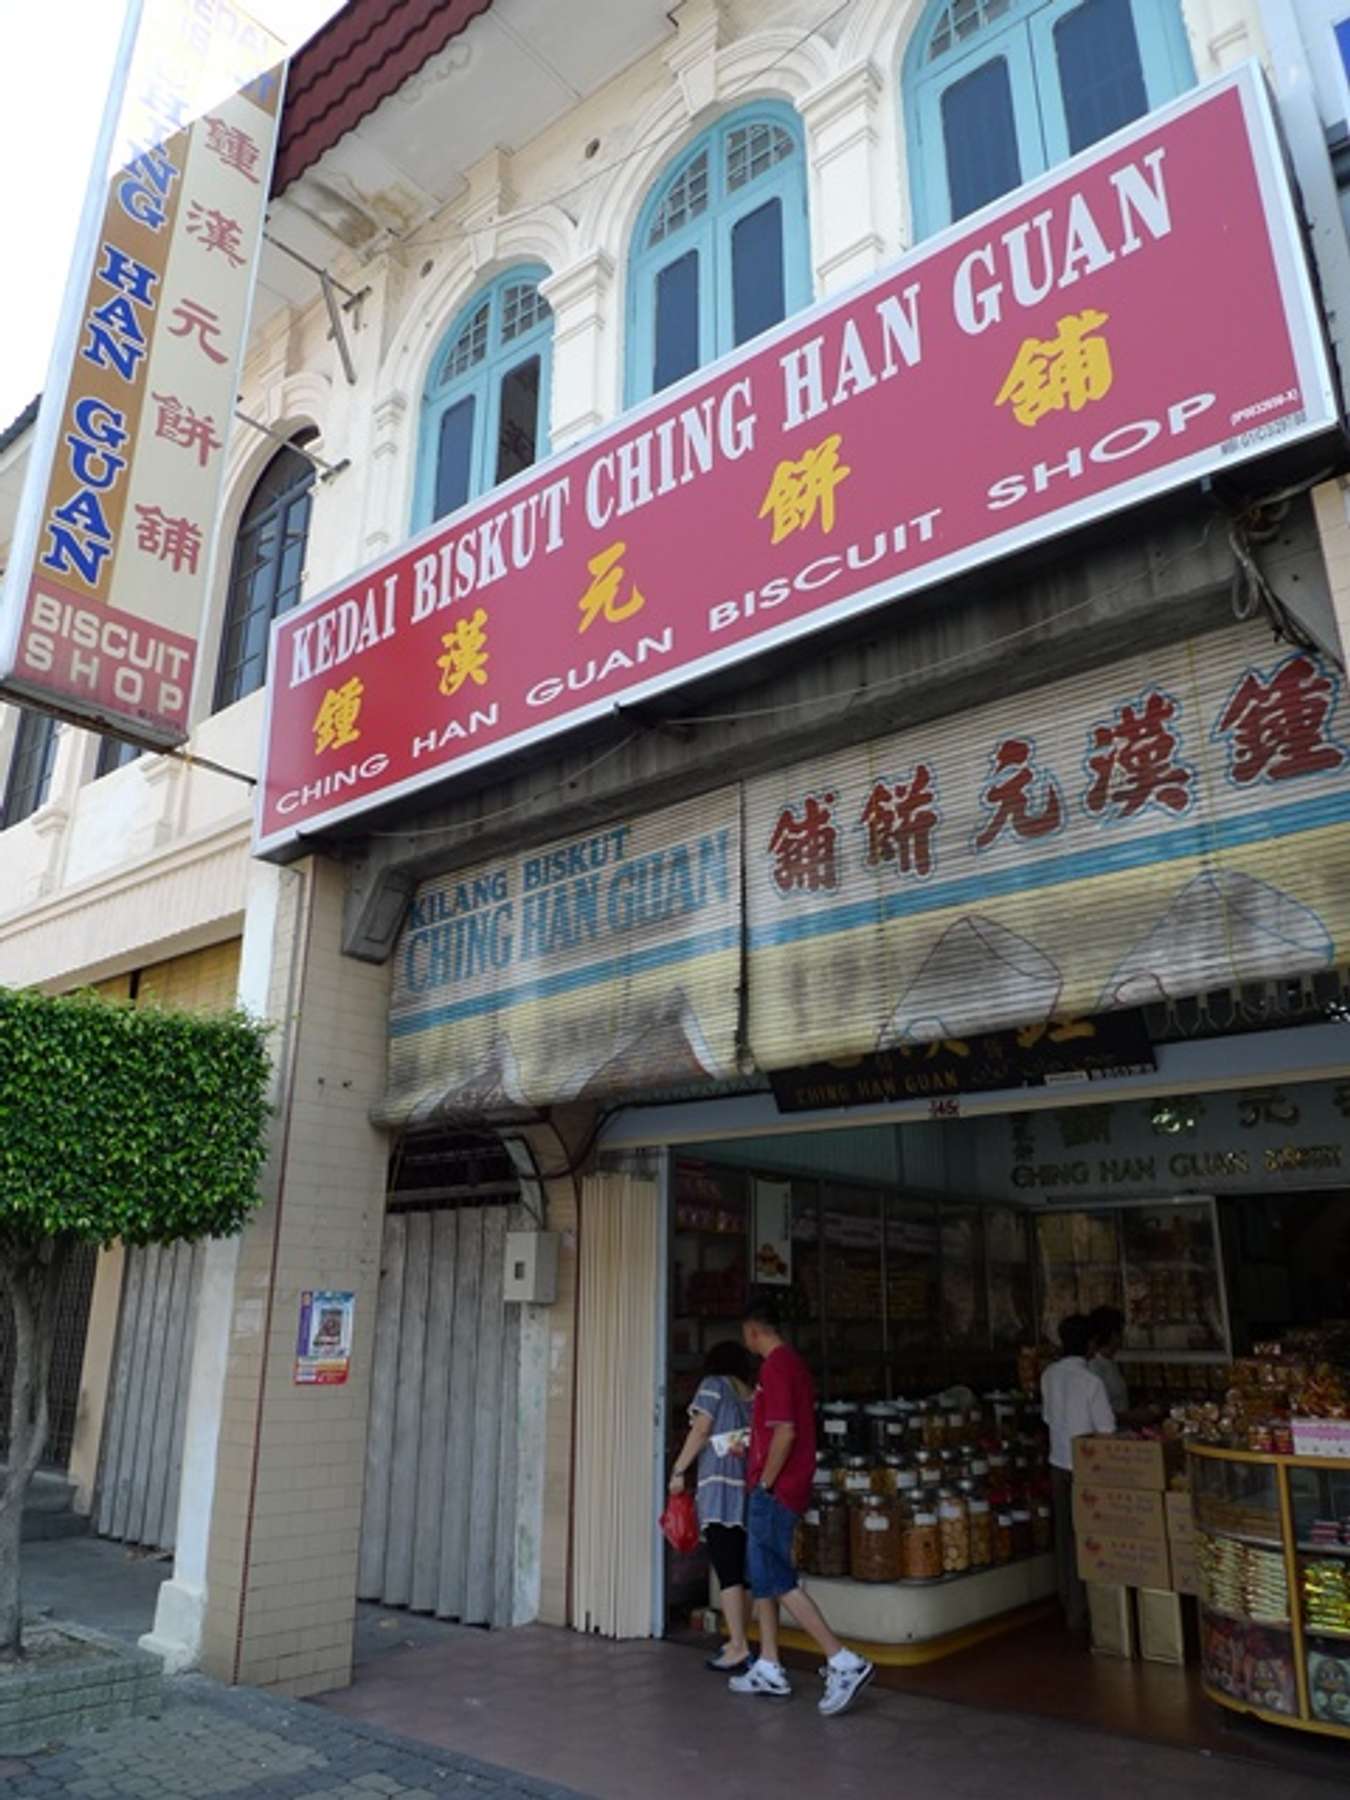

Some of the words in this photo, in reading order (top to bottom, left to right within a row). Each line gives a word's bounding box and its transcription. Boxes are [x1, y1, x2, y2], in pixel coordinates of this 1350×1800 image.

[82, 244, 158, 380] HAN
[288, 574, 399, 689] KEDAI
[411, 475, 571, 624] BISKUT
[585, 377, 756, 530] CHING
[780, 281, 922, 432] HAN
[953, 146, 1173, 336] GUAN
[41, 398, 128, 585] GUAN
[31, 593, 190, 680] BISCUIT
[275, 753, 391, 815] CHING
[411, 703, 500, 758] HAN
[525, 627, 675, 707] GUAN
[708, 508, 943, 633] BISCUIT
[986, 392, 1217, 511] SHOP
[25, 632, 184, 715] SHOP
[405, 902, 515, 993] CHING
[520, 875, 601, 961] HAN
[606, 829, 730, 931] GUAN
[409, 869, 508, 930] KILANG
[522, 826, 631, 888] BISKUT
[904, 1071, 959, 1094] GUAN
[1011, 1161, 1090, 1188] CHING
[1099, 1155, 1155, 1184] HAN
[1168, 1149, 1249, 1179] GUAN
